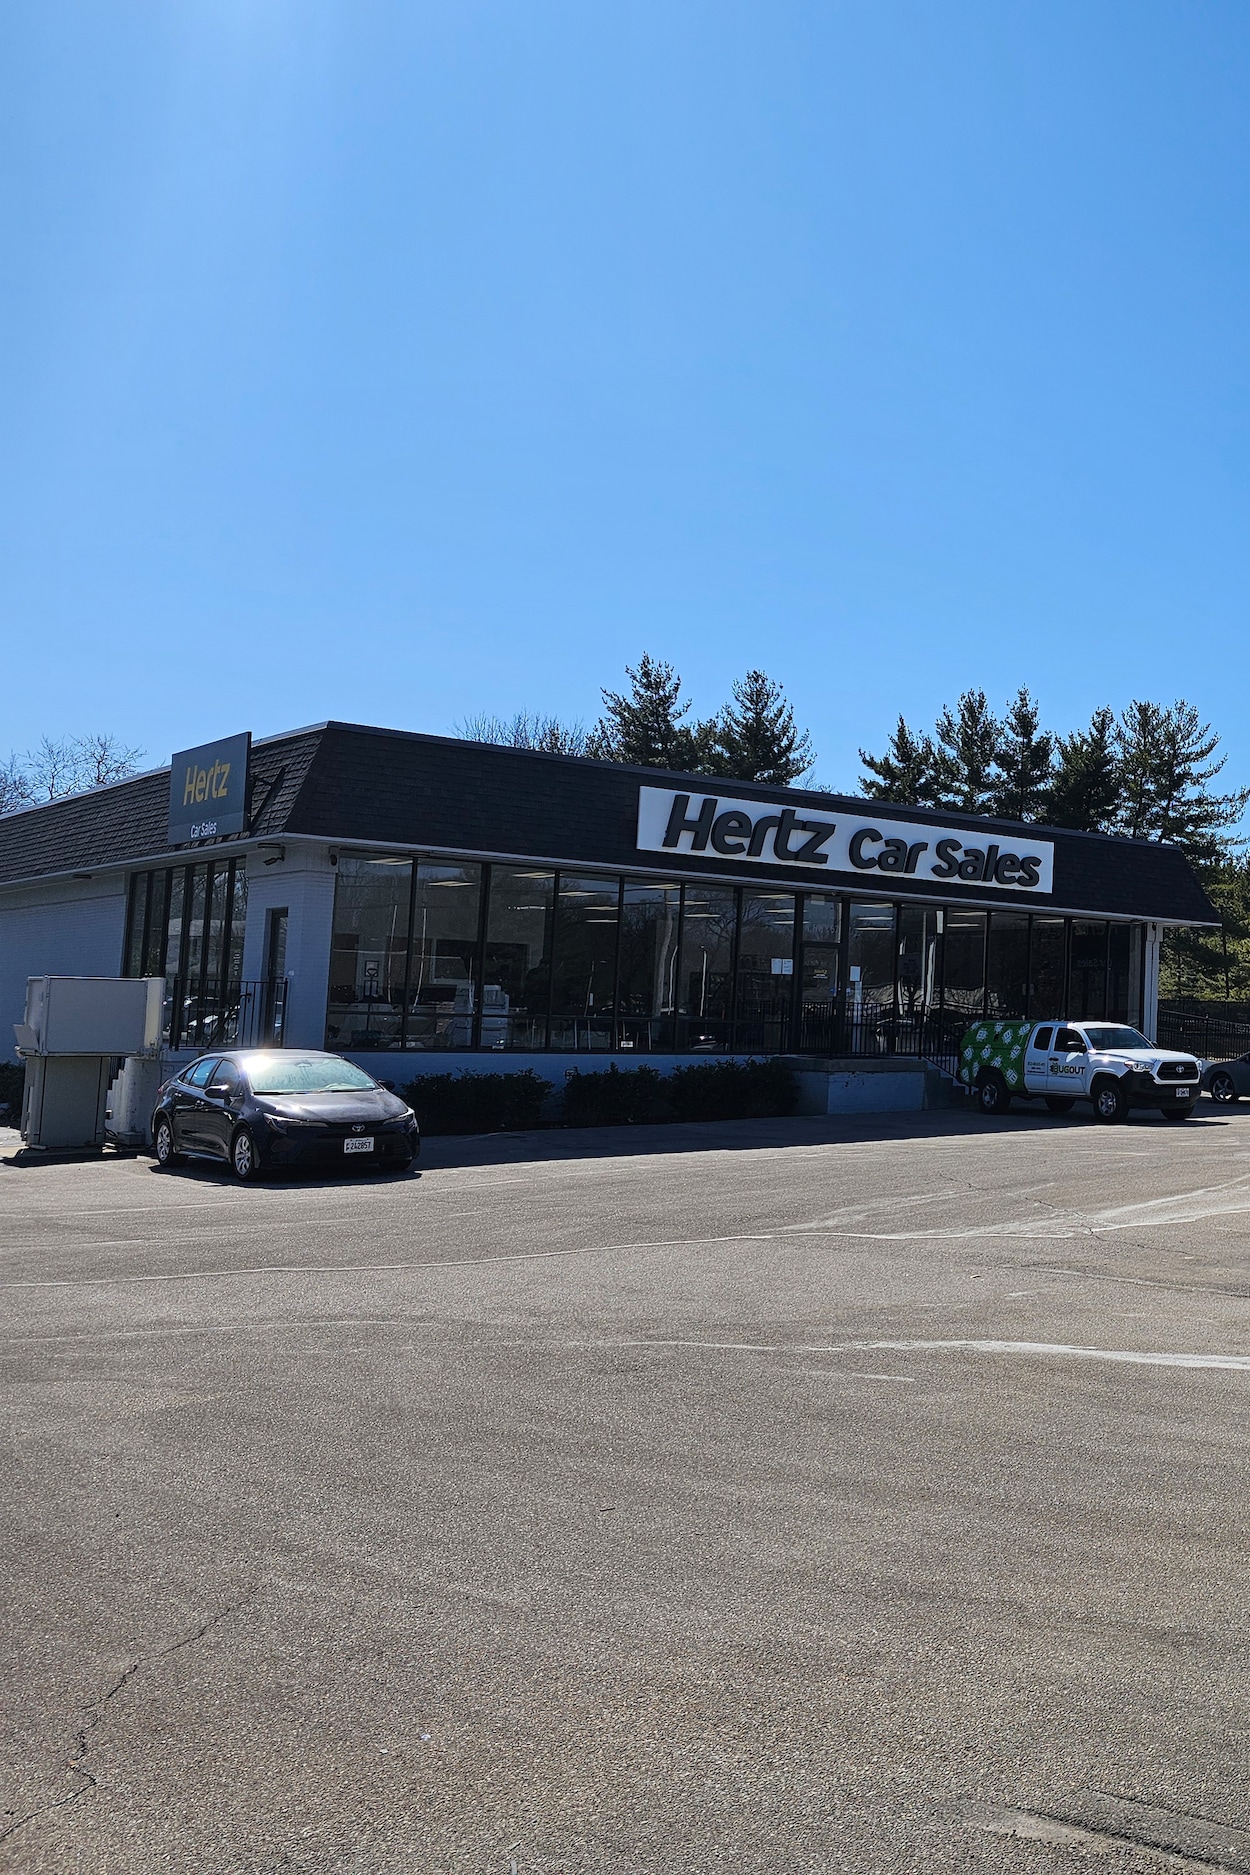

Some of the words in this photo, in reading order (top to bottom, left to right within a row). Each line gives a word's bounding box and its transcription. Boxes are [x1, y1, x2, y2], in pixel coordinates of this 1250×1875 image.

[183, 759, 231, 806] Hertz
[190, 824, 201, 838] Car
[201, 821, 217, 836] Sales
[662, 794, 836, 864] Hertz
[849, 828, 928, 874] Car
[931, 838, 1042, 887] Sales
